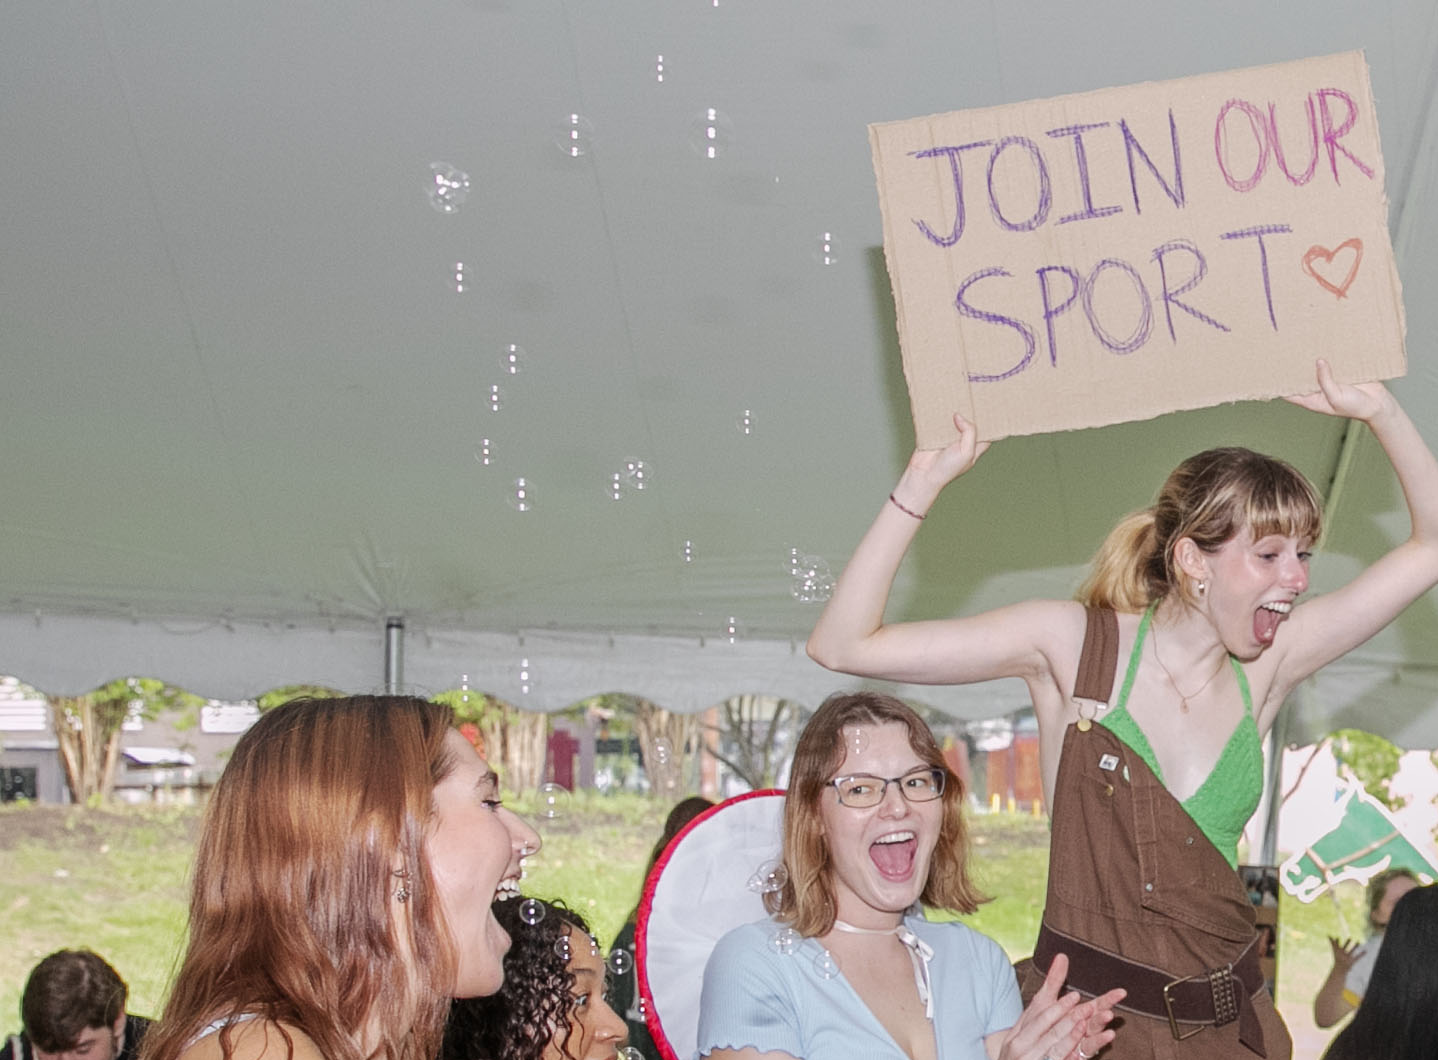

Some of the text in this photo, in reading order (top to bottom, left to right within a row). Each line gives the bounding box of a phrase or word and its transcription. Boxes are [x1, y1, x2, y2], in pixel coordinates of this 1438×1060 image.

[905, 87, 1375, 248] JOIN OUR
[954, 224, 1293, 383] SPORT
